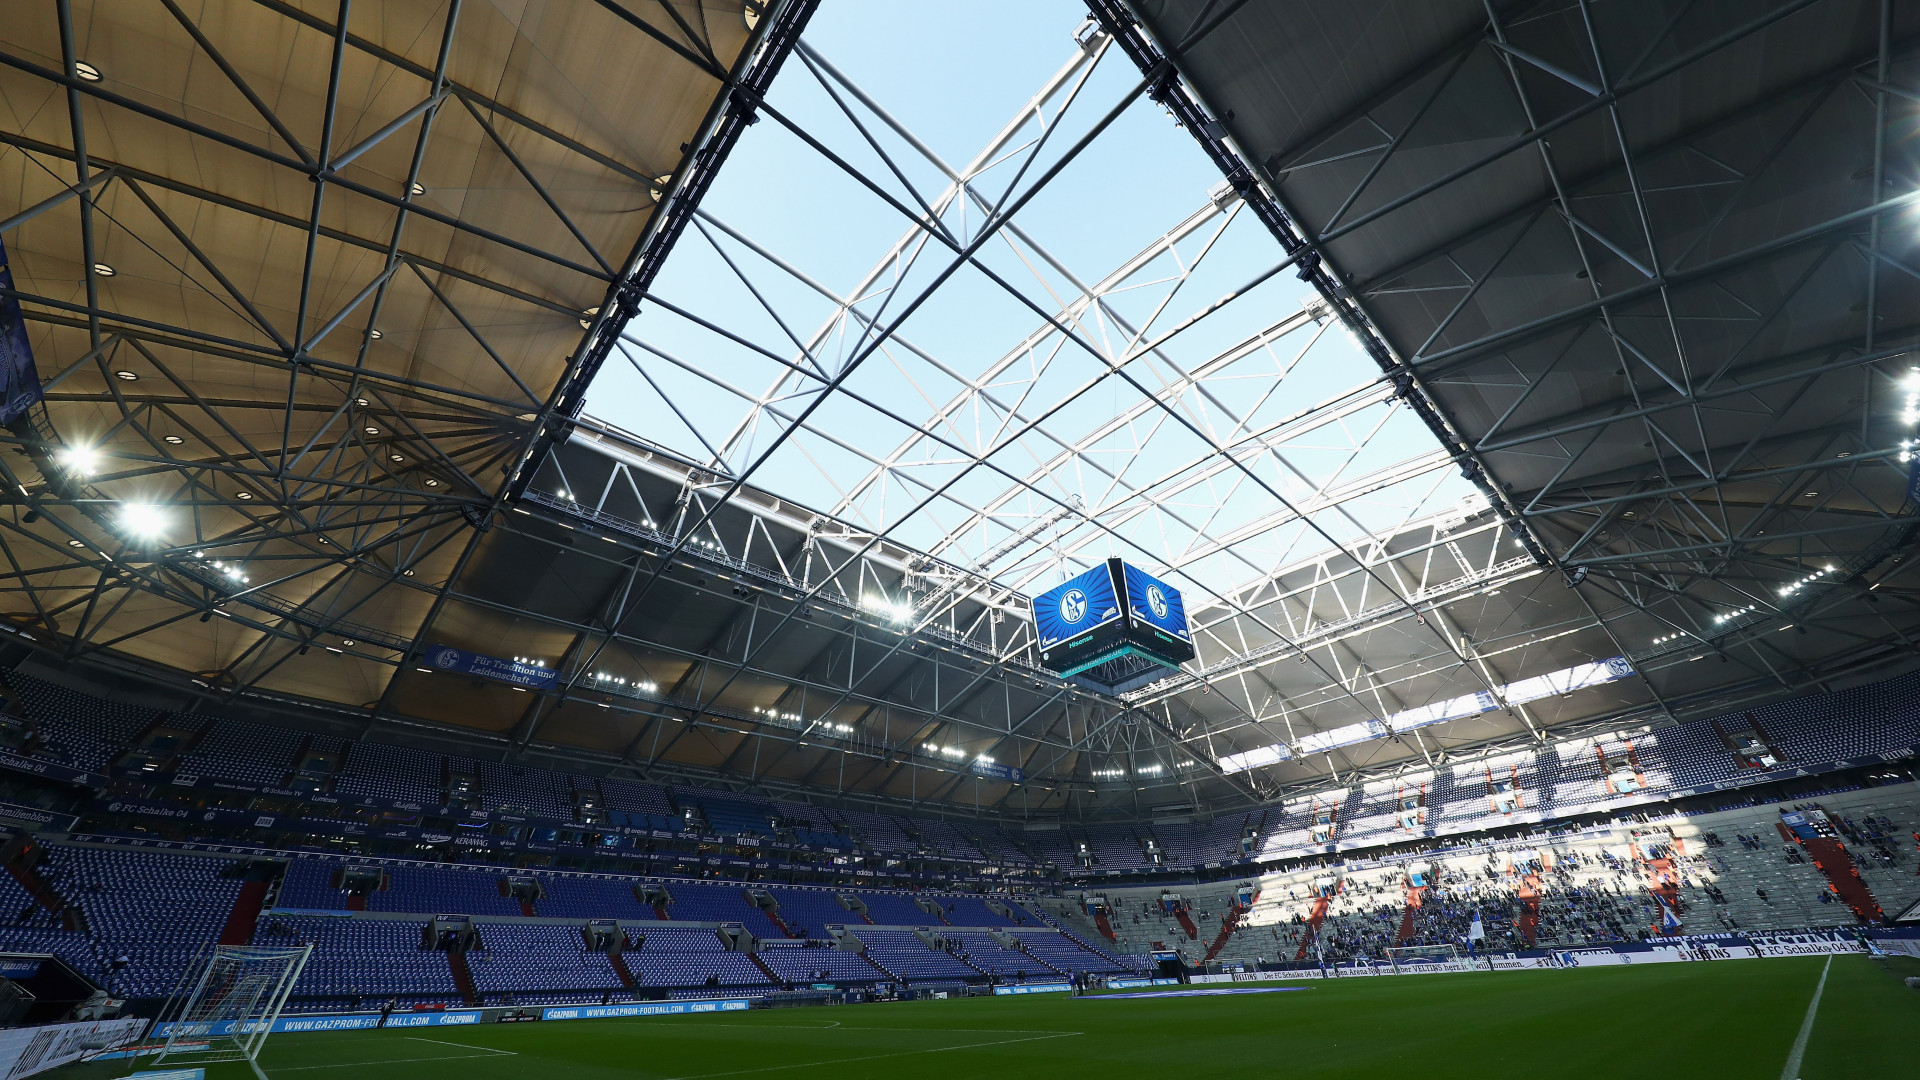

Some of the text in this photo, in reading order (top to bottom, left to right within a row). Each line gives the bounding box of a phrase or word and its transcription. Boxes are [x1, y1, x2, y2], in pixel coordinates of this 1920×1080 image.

[1069, 634, 1094, 649] Hisense
[1154, 630, 1173, 644] Hisense
[474, 655, 556, 679] Für Tradition und
[468, 665, 531, 684] Leidenschaft
[1877, 746, 1916, 761] VELTINS
[0, 755, 47, 773] Schalke 04
[1722, 775, 1772, 788] Wir leben dich.
[269, 787, 293, 796] Schalke
[121, 804, 189, 819] FC Schalke 04
[455, 836, 489, 848] KERAMAG
[736, 837, 760, 847] VELTINS
[1744, 947, 1766, 957] Dr
[1766, 946, 1782, 956] FC
[1783, 943, 1832, 955] Schalke
[1831, 942, 1849, 952] 04
[33, 962, 41, 971] 4
[1282, 970, 1304, 979] Schalke
[1412, 963, 1443, 973] VELTINS
[1475, 960, 1526, 971] willommen.
[1235, 974, 1257, 983] VELTINS
[586, 1005, 685, 1017] WWW.GAZPROM-FOOTBALL.COM
[695, 1003, 716, 1012] GAZPROM
[726, 1001, 746, 1010] GAZPROM
[447, 1014, 476, 1026] GAZPROM
[553, 1009, 579, 1018] GAZPROM
[284, 1016, 430, 1032] WWW.GAZPROM-FOOBALL.COM
